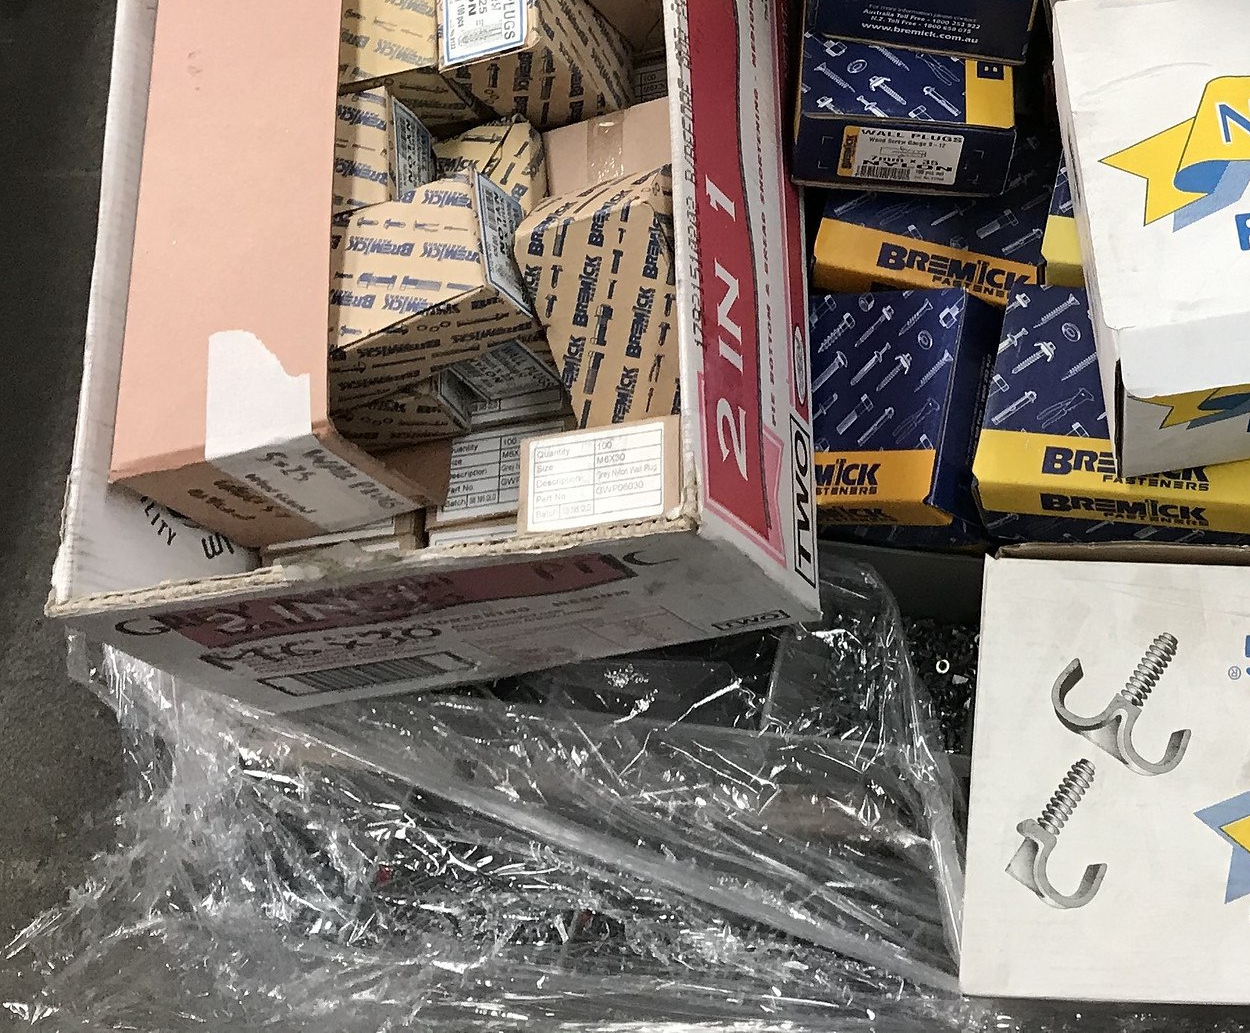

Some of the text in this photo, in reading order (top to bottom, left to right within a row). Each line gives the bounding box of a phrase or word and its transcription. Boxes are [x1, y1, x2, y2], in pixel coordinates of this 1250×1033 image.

[861, 22, 979, 44] www.bremick.com.au
[863, 159, 953, 172] NYLON
[877, 241, 1030, 288] BREMICK
[573, 254, 602, 328] BREMICK
[625, 286, 656, 359] BREMICK
[704, 174, 748, 482] 2 IN 1
[451, 468, 488, 480] escription
[814, 458, 882, 487] MICK
[1102, 474, 1210, 492] FASTENERS
[794, 428, 812, 568] TWO
[815, 485, 878, 496] STENERS
[1039, 492, 1208, 523] BREMICK
